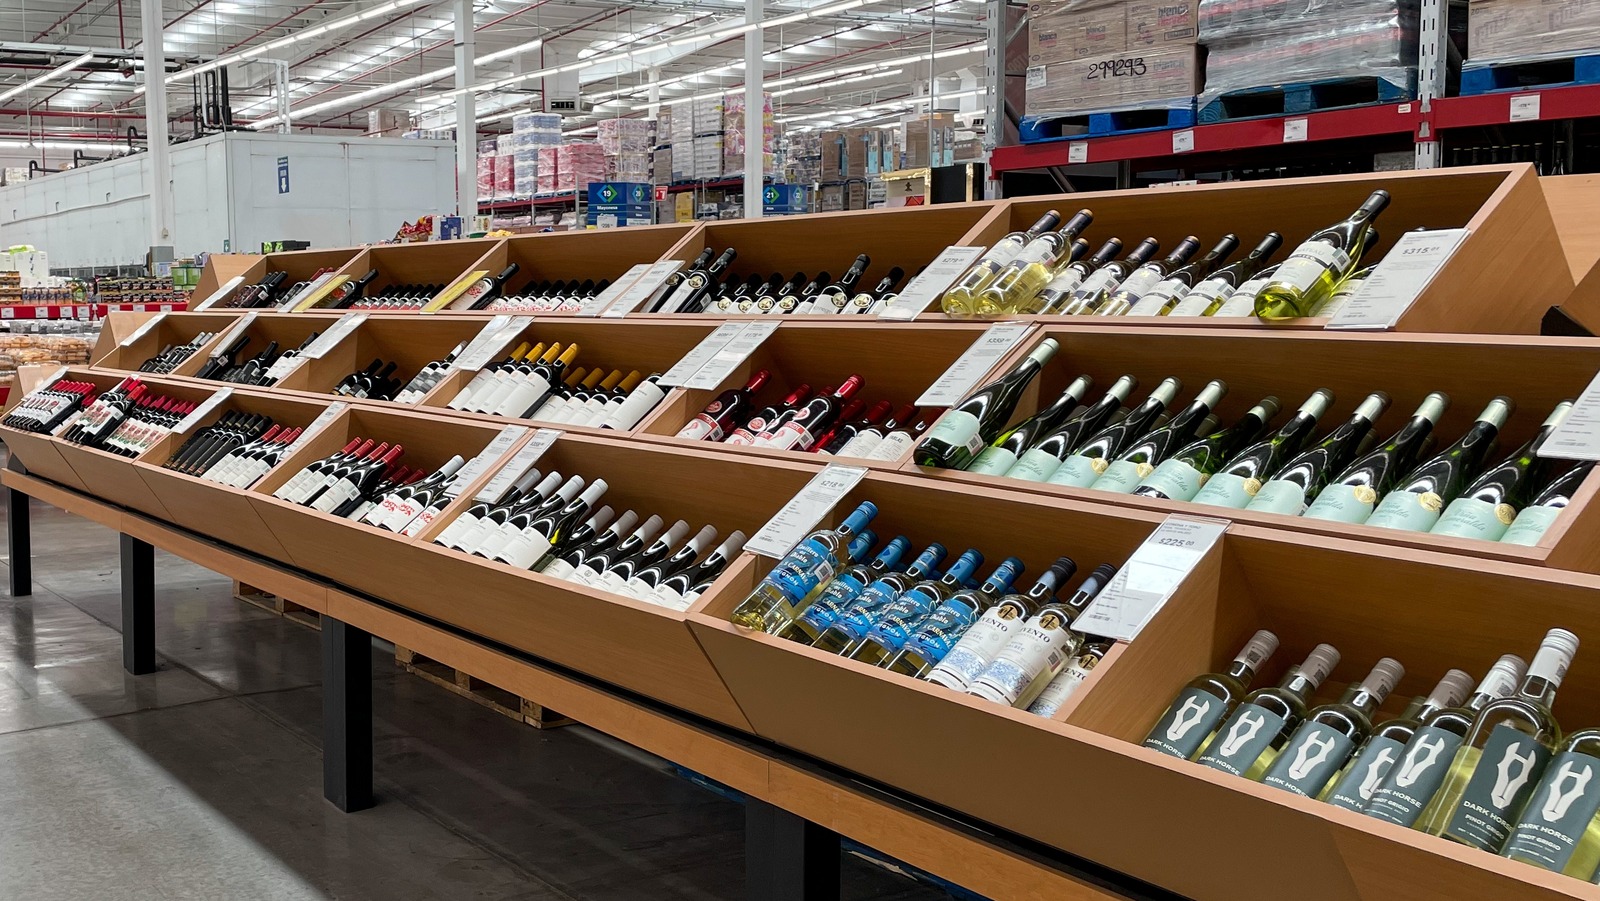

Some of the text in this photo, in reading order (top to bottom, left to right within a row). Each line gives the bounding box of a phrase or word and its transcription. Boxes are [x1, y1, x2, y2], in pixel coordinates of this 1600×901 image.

[1087, 57, 1147, 80] 299293
[1402, 246, 1430, 255] $315
[820, 480, 838, 488] $218
[1158, 537, 1185, 547] $225
[1146, 738, 1163, 746] DARK
[1200, 755, 1241, 776] DARK HORSE
[1265, 775, 1285, 785] DARK
[1334, 794, 1356, 805] DARK
[1392, 791, 1422, 809] HORSE
[1387, 801, 1410, 813] GRIGIO
[1463, 800, 1490, 816] DARK
[1465, 813, 1487, 827] PINOT
[1485, 824, 1505, 840] GRIGIO
[1517, 823, 1574, 846] DARK HORSE
[1536, 837, 1562, 851] GRIGIO
